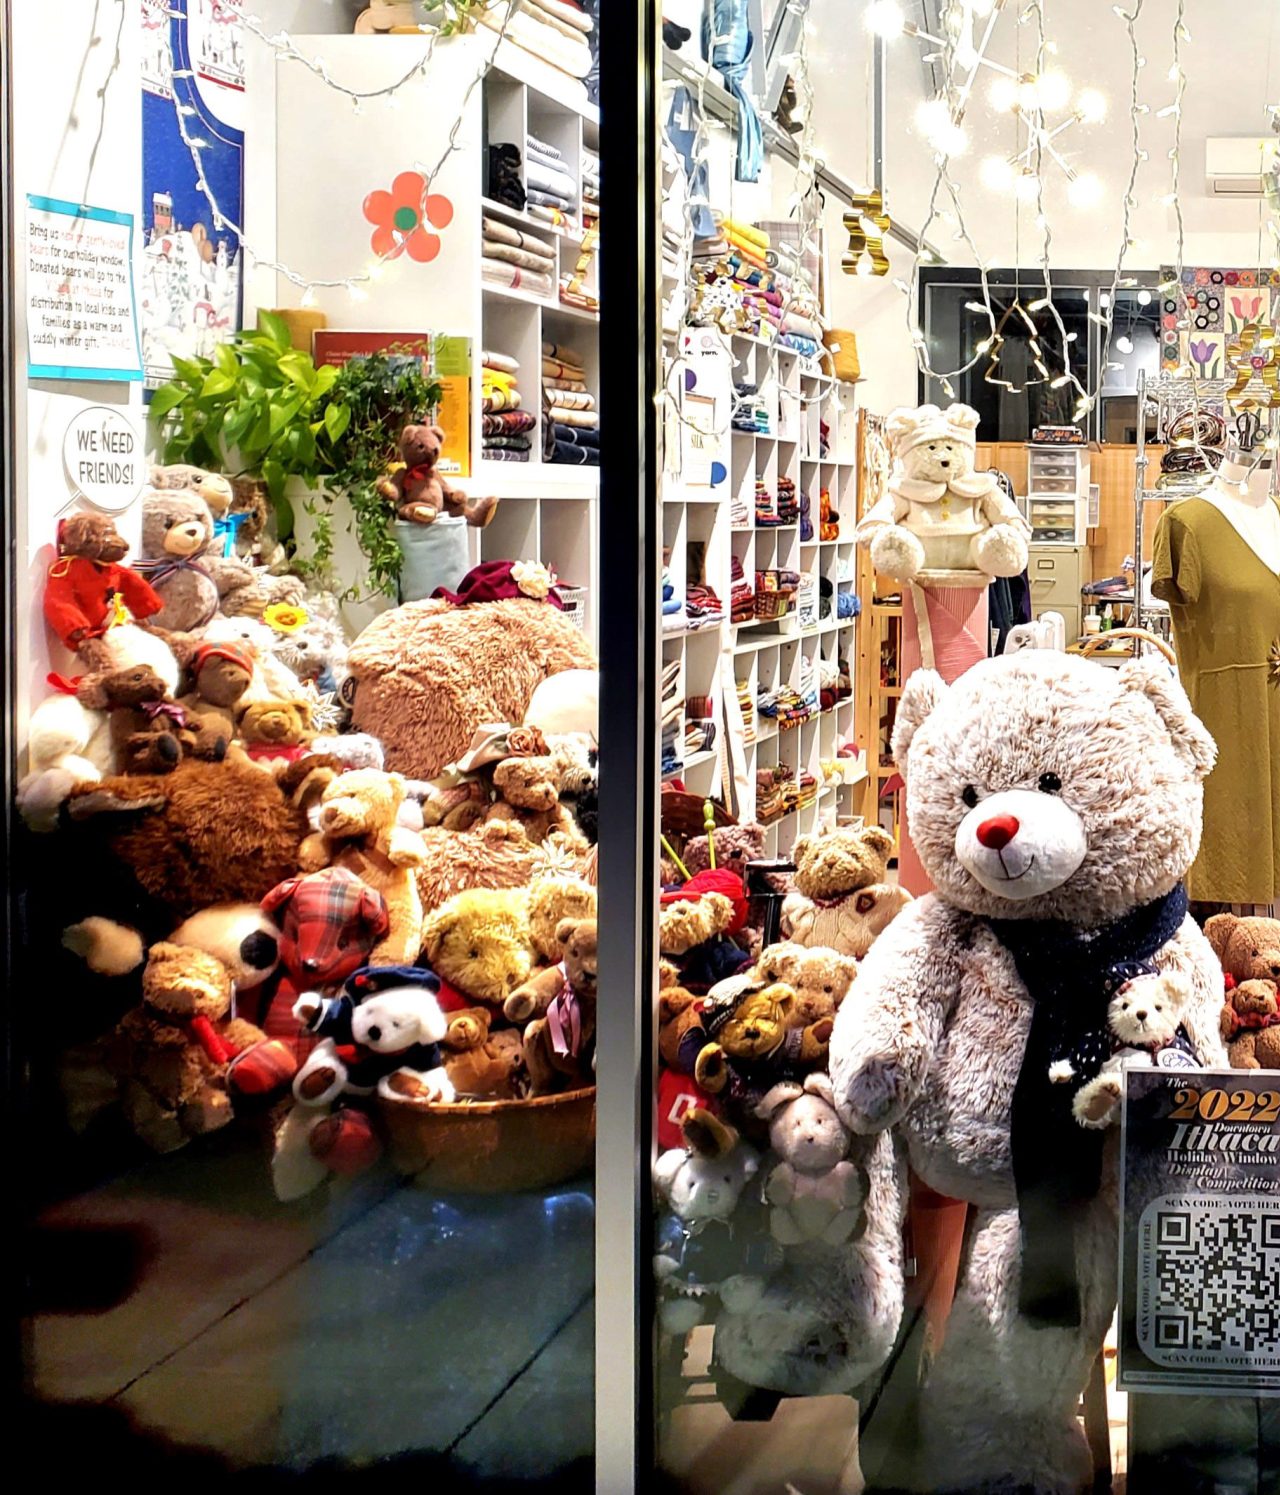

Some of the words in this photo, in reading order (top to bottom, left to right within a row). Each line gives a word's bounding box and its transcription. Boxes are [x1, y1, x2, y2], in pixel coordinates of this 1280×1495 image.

[29, 222, 48, 241] Bring
[50, 229, 59, 239] us
[50, 244, 61, 257] for
[30, 258, 59, 275] Donated
[62, 264, 81, 278] bears
[83, 267, 95, 280] will
[97, 270, 105, 283] go
[107, 271, 114, 282] to
[115, 272, 126, 284] the
[104, 286, 114, 298] for
[30, 295, 73, 312] distribution
[75, 301, 82, 313] to
[85, 301, 99, 314] local
[102, 302, 116, 316] kids
[118, 306, 130, 318] and
[42, 314, 71, 329] families
[73, 319, 81, 330] as
[90, 321, 108, 332] warm
[110, 322, 122, 333] and
[33, 333, 56, 349] cuddly
[60, 334, 82, 347] winter
[76, 429, 98, 452] WE
[102, 430, 134, 454] NEED
[79, 461, 134, 486] FRIENDS!
[1166, 1077, 1188, 1088] The
[1214, 1122, 1271, 1134] Downtown
[1168, 1123, 1280, 1153] Ithaca
[1166, 1150, 1219, 1165] Holiday
[1222, 1151, 1279, 1165] Window
[1168, 1162, 1224, 1180] Display
[1196, 1175, 1280, 1191] Competition
[1165, 1199, 1190, 1208] SCAN
[1193, 1200, 1222, 1209] CODE
[1227, 1200, 1255, 1210] VOTE
[1161, 1354, 1187, 1364] SCAN
